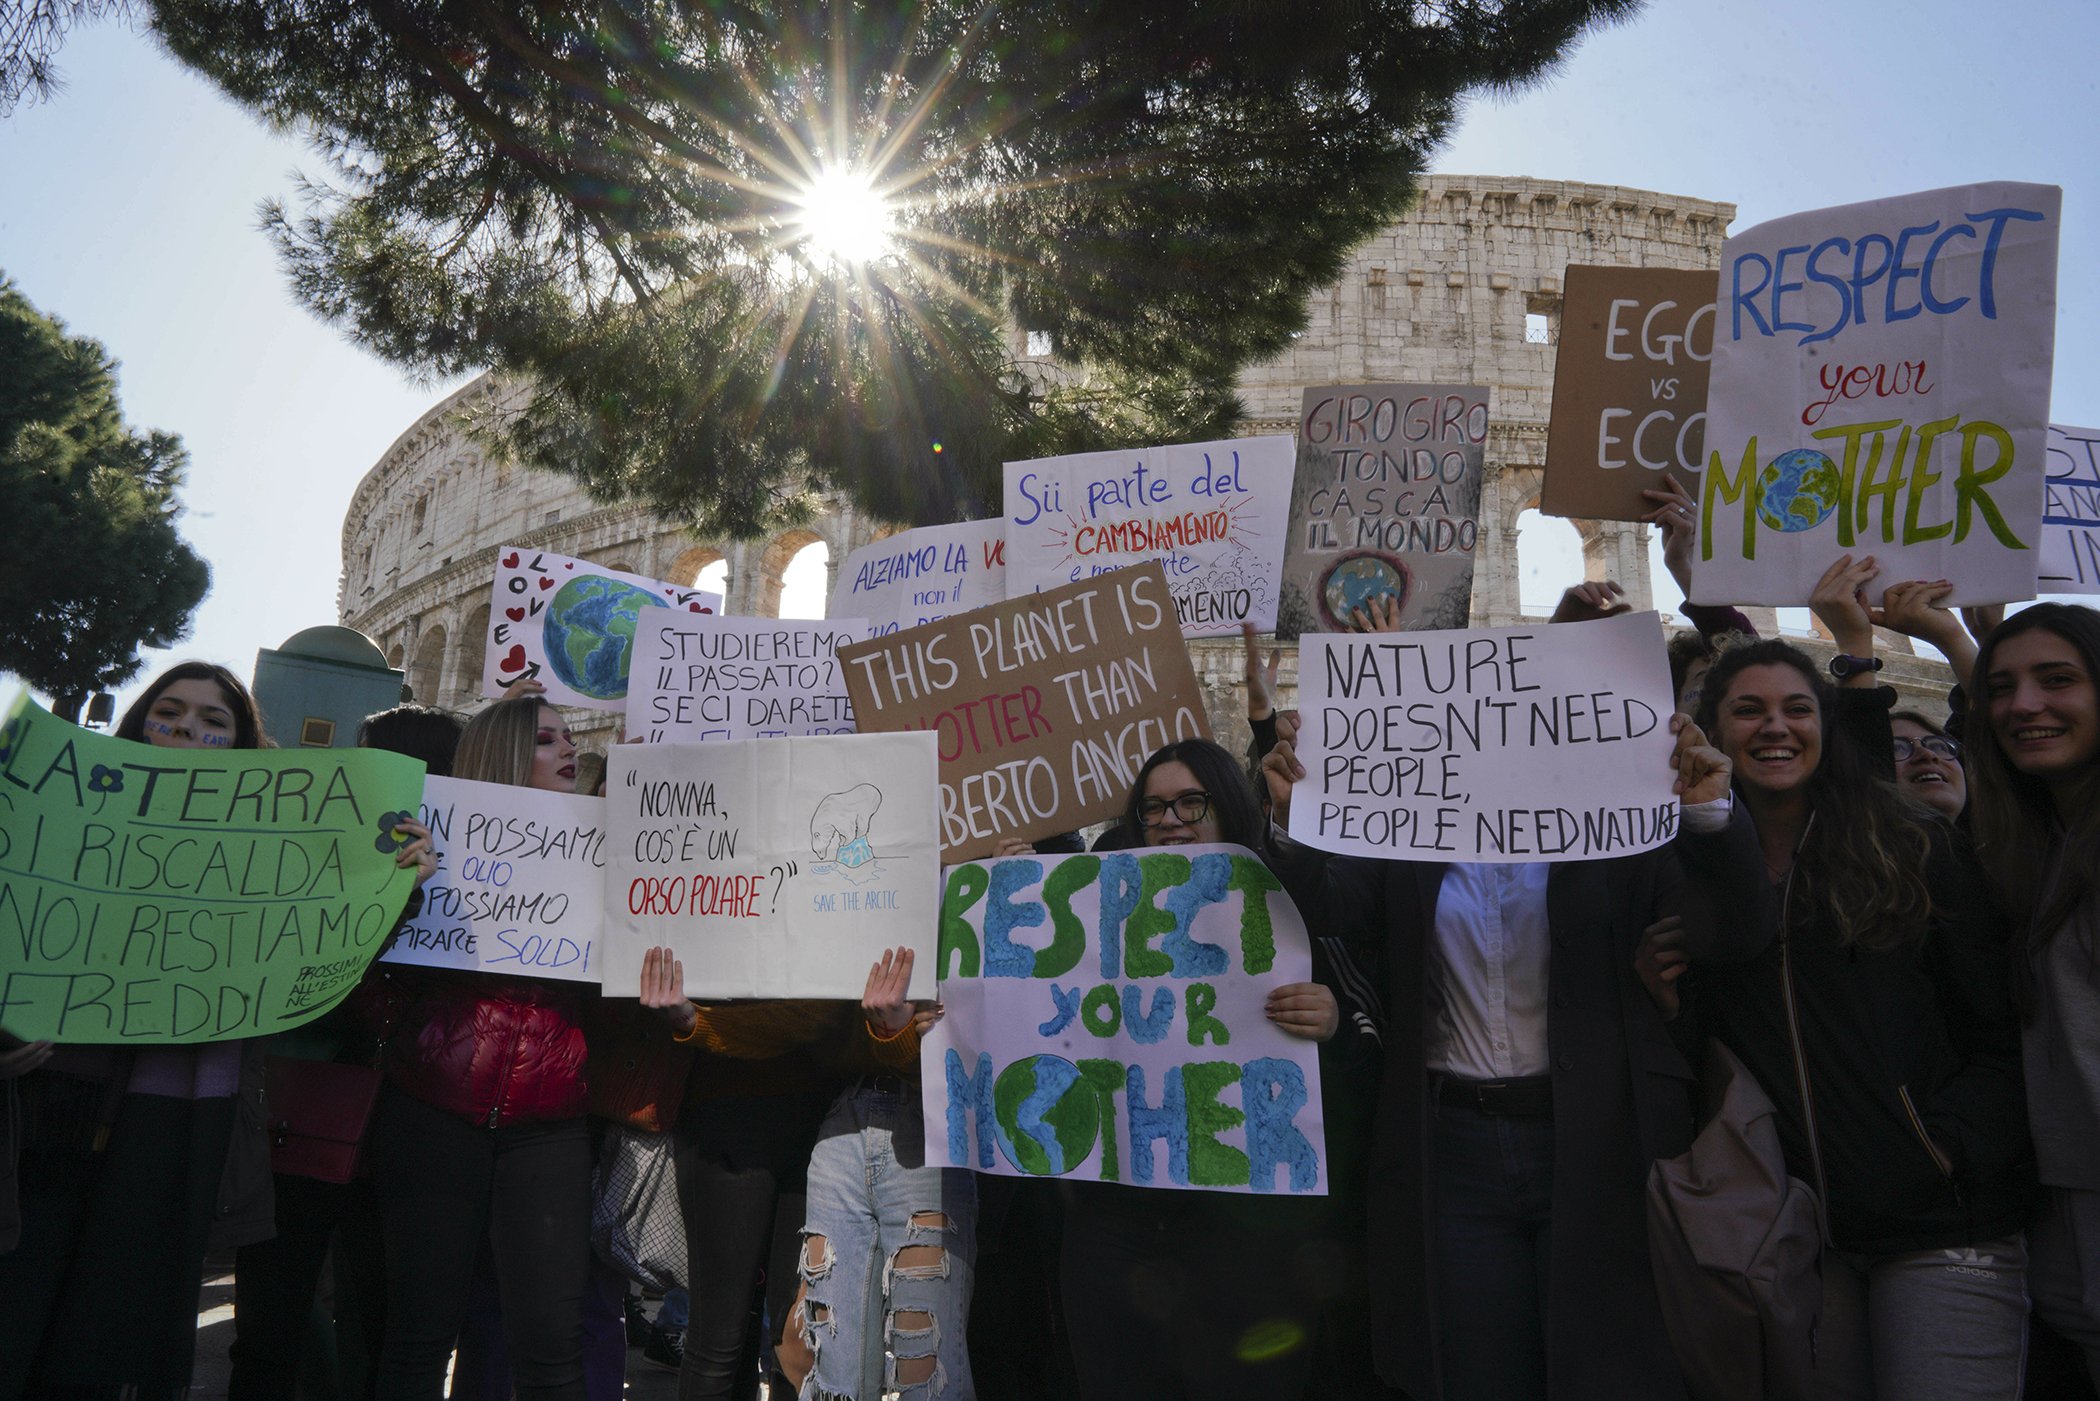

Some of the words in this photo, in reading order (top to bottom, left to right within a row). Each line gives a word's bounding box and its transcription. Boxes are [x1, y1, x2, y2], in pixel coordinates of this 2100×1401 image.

[1732, 207, 2045, 347] RESPECT
[1800, 360, 1935, 426] your
[1014, 473, 1063, 526] Sii
[1087, 462, 1172, 518] parte
[1190, 451, 1248, 496] del
[1331, 449, 1466, 485] TONDO
[1700, 413, 2030, 562] MOTHER
[1309, 485, 1451, 517] CASCA
[1074, 510, 1228, 556] CAMBIAMENTO
[1308, 523, 1338, 549] IL
[1356, 517, 1477, 552] MONDO
[853, 545, 936, 594] ALZIAMO
[944, 543, 968, 573] LA
[1148, 551, 1200, 576] rte
[914, 590, 945, 606] non
[952, 578, 962, 602] il
[850, 633, 959, 711] THIS
[969, 590, 1099, 679] PLANET
[1115, 575, 1162, 636] IS
[1325, 635, 1540, 699] NATURE
[657, 666, 679, 690] IL
[688, 661, 833, 692] PASSATO?
[747, 695, 855, 726] DARETE
[904, 685, 1053, 762] OTTER
[1052, 646, 1158, 726] THAN
[1323, 696, 1517, 752] DOESN'T
[1530, 691, 1657, 747] NEED
[3, 719, 84, 807] LA
[122, 763, 365, 826] TERRA
[1323, 754, 1471, 804] PEOPLE,
[939, 755, 1059, 851] BERTO
[1318, 802, 1460, 851] PEOPLE
[1475, 807, 1579, 855] NEED
[74, 823, 344, 897] RISCALDA
[707, 827, 739, 861] UN
[462, 856, 513, 887] OLIO
[628, 876, 686, 916] ORSO
[427, 886, 569, 925] POSSIAMO
[813, 894, 836, 912] SAVE
[840, 891, 860, 911] THE
[864, 889, 900, 911] ARCTIC
[937, 852, 1282, 980] RESPECT
[0, 883, 100, 965] NOI
[120, 902, 385, 973] RESTIAMO
[485, 929, 591, 973] SOLDI
[296, 954, 362, 982] PROSSIMI
[0, 972, 268, 1038] FREDDI
[1038, 982, 1231, 1047] YOUR
[945, 1047, 1319, 1192] MOTHER
[1945, 1264, 1998, 1280] adidas
